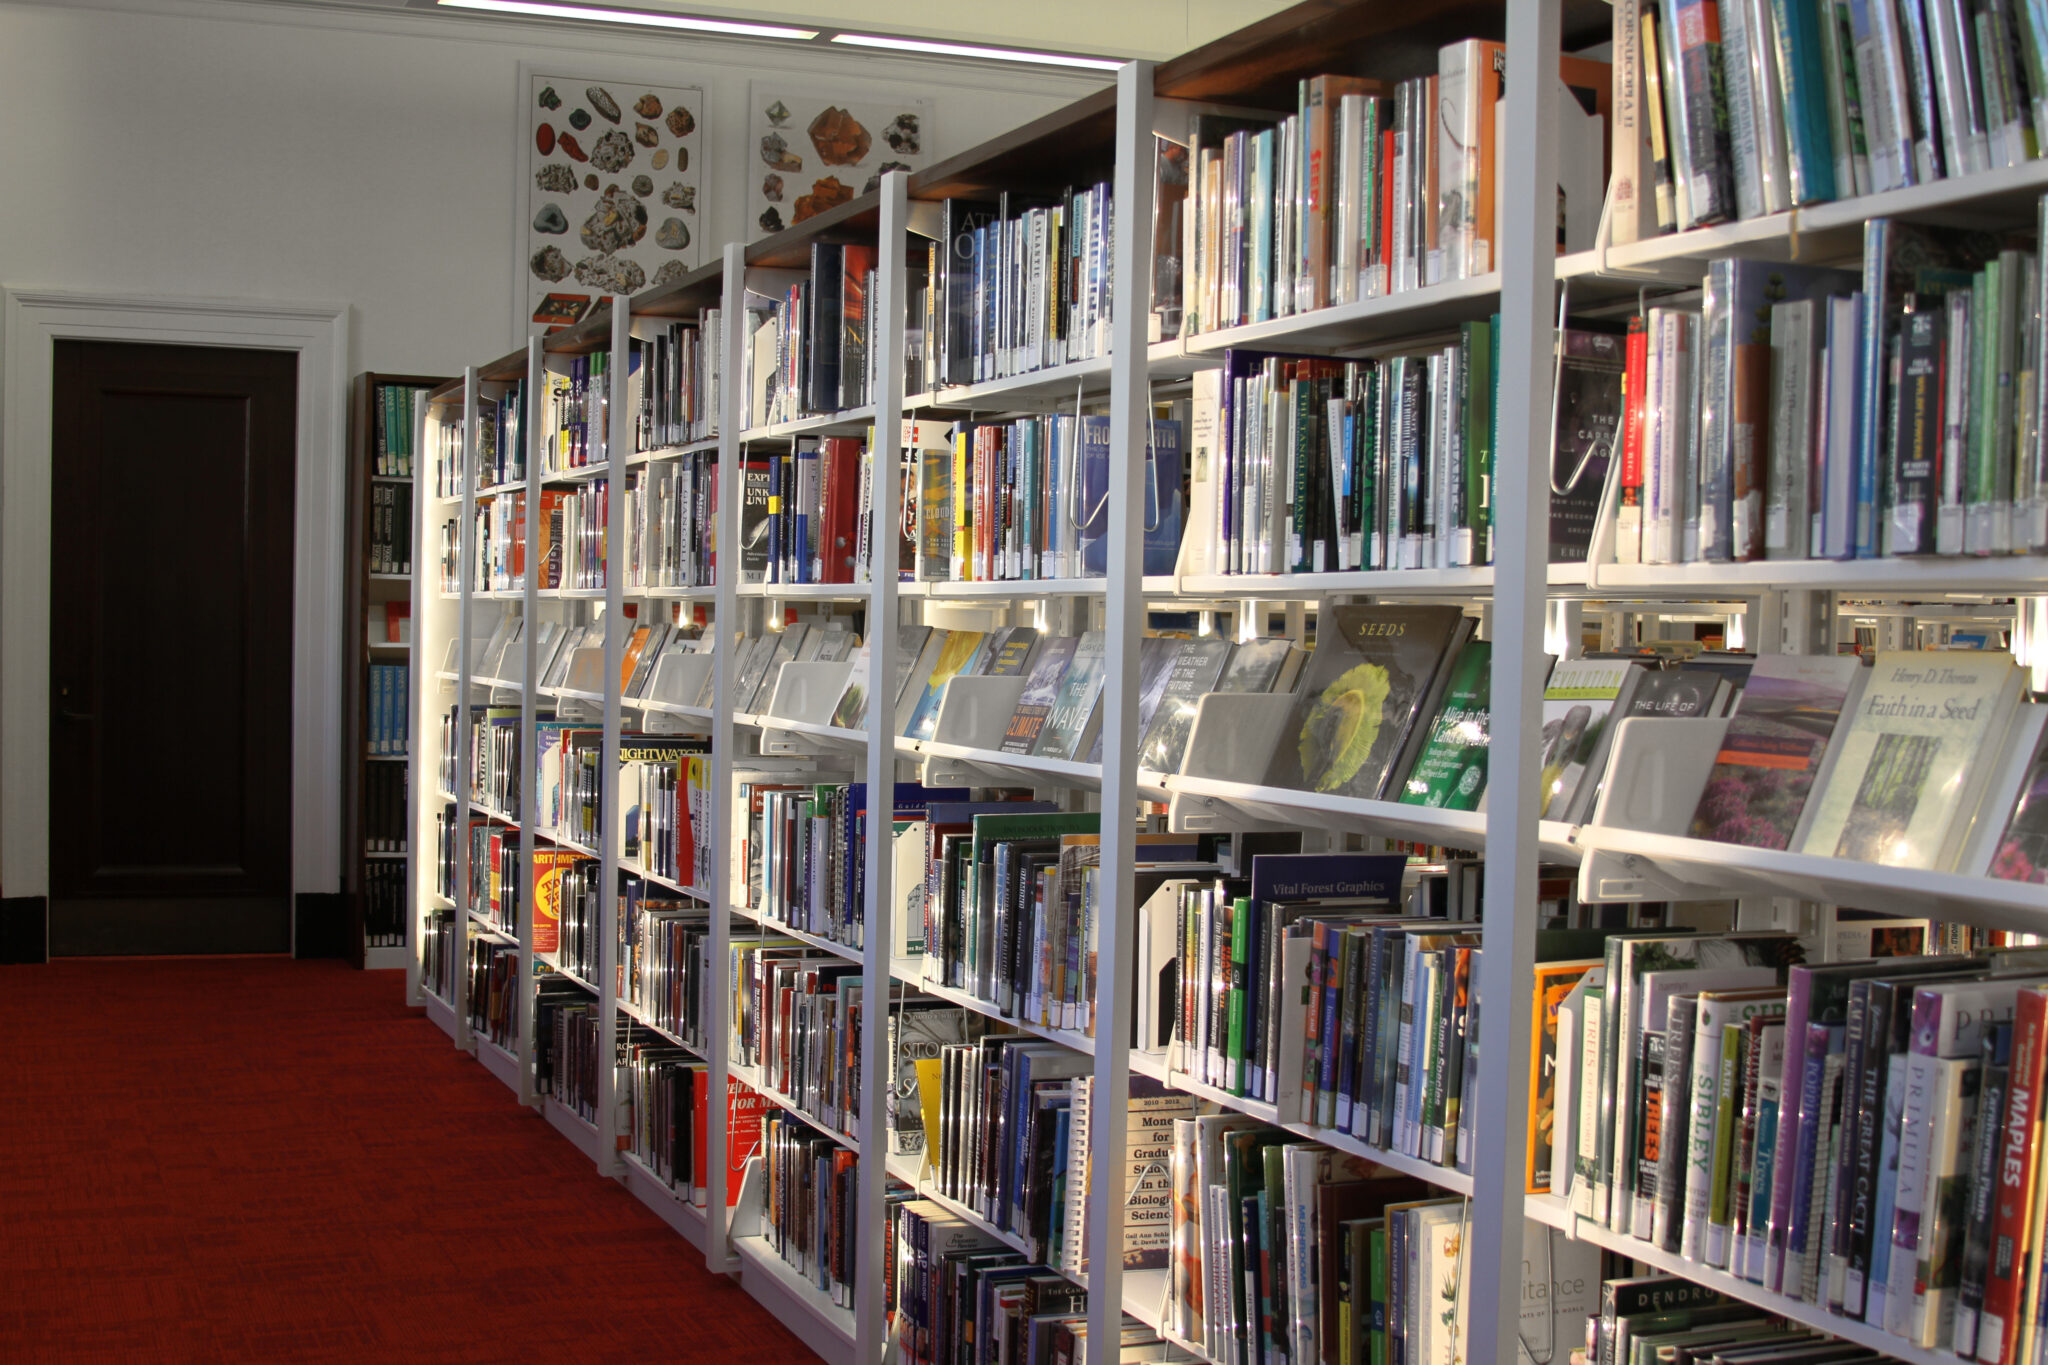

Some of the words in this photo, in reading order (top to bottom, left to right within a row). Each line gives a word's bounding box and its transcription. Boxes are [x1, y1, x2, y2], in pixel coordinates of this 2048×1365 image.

[1033, 219, 1041, 278] ATLANTIC
[1592, 414, 1614, 425] THE
[1913, 375, 1926, 461] WILDFLOWERS
[1298, 425, 1306, 490] TANGLED
[821, 451, 830, 522] Chemistry
[681, 489, 690, 564] GIANCOLI
[1182, 644, 1197, 654] THE
[1358, 622, 1407, 637] SEEDS
[1177, 656, 1209, 667] WEATHER
[1184, 669, 1197, 679] THE
[1551, 669, 1623, 689] EVOLUTION
[1890, 668, 1922, 688] Henry
[1071, 682, 1088, 697] THE
[1168, 680, 1193, 691] FUTURE
[1634, 700, 1652, 710] THE
[1655, 701, 1676, 711] LIFE
[1679, 701, 1696, 712] OF
[1006, 717, 1043, 738] CLIMATE
[1046, 705, 1090, 732] WAVE
[1441, 706, 1465, 723] Alice
[1867, 694, 1907, 717] Faith
[1939, 698, 1981, 721] Seed
[1019, 867, 1027, 909] DIAMOND
[1272, 883, 1297, 895] Vital
[1301, 882, 1334, 894] Forest
[1336, 880, 1385, 896] Graphics
[1370, 936, 1379, 985] STEPHEN
[1311, 991, 1319, 1016] Insects
[1325, 1005, 1334, 1034] Insects
[1849, 996, 1863, 1041] CACTI
[1365, 1012, 1374, 1053] GOULD
[1438, 1017, 1448, 1052] Super
[1585, 1019, 1597, 1068] TREES
[1667, 1013, 1683, 1084] TREES
[1322, 1047, 1331, 1082] Gardens
[1435, 1057, 1445, 1106] Species
[1721, 1058, 1732, 1100] BARK
[2023, 1038, 2034, 1085] Illustrated
[730, 1099, 755, 1110] FOR
[1802, 1061, 1819, 1126] POPPIES
[1864, 1068, 1877, 1105] THE
[1152, 1131, 1169, 1142] for
[1644, 1089, 1663, 1162] TREES
[1692, 1075, 1712, 1175] SIBLEY
[1858, 1110, 1875, 1172] GREAT
[1899, 1065, 1925, 1195] PRIMULA
[1981, 1087, 1999, 1173] Carnivorous
[2003, 1087, 2030, 1188] MAPLES
[1755, 1149, 1771, 1195] Trees
[1855, 1177, 1870, 1234] CACTI
[1975, 1176, 1990, 1223] Plants
[1299, 1204, 1308, 1290] MUSHROOMS
